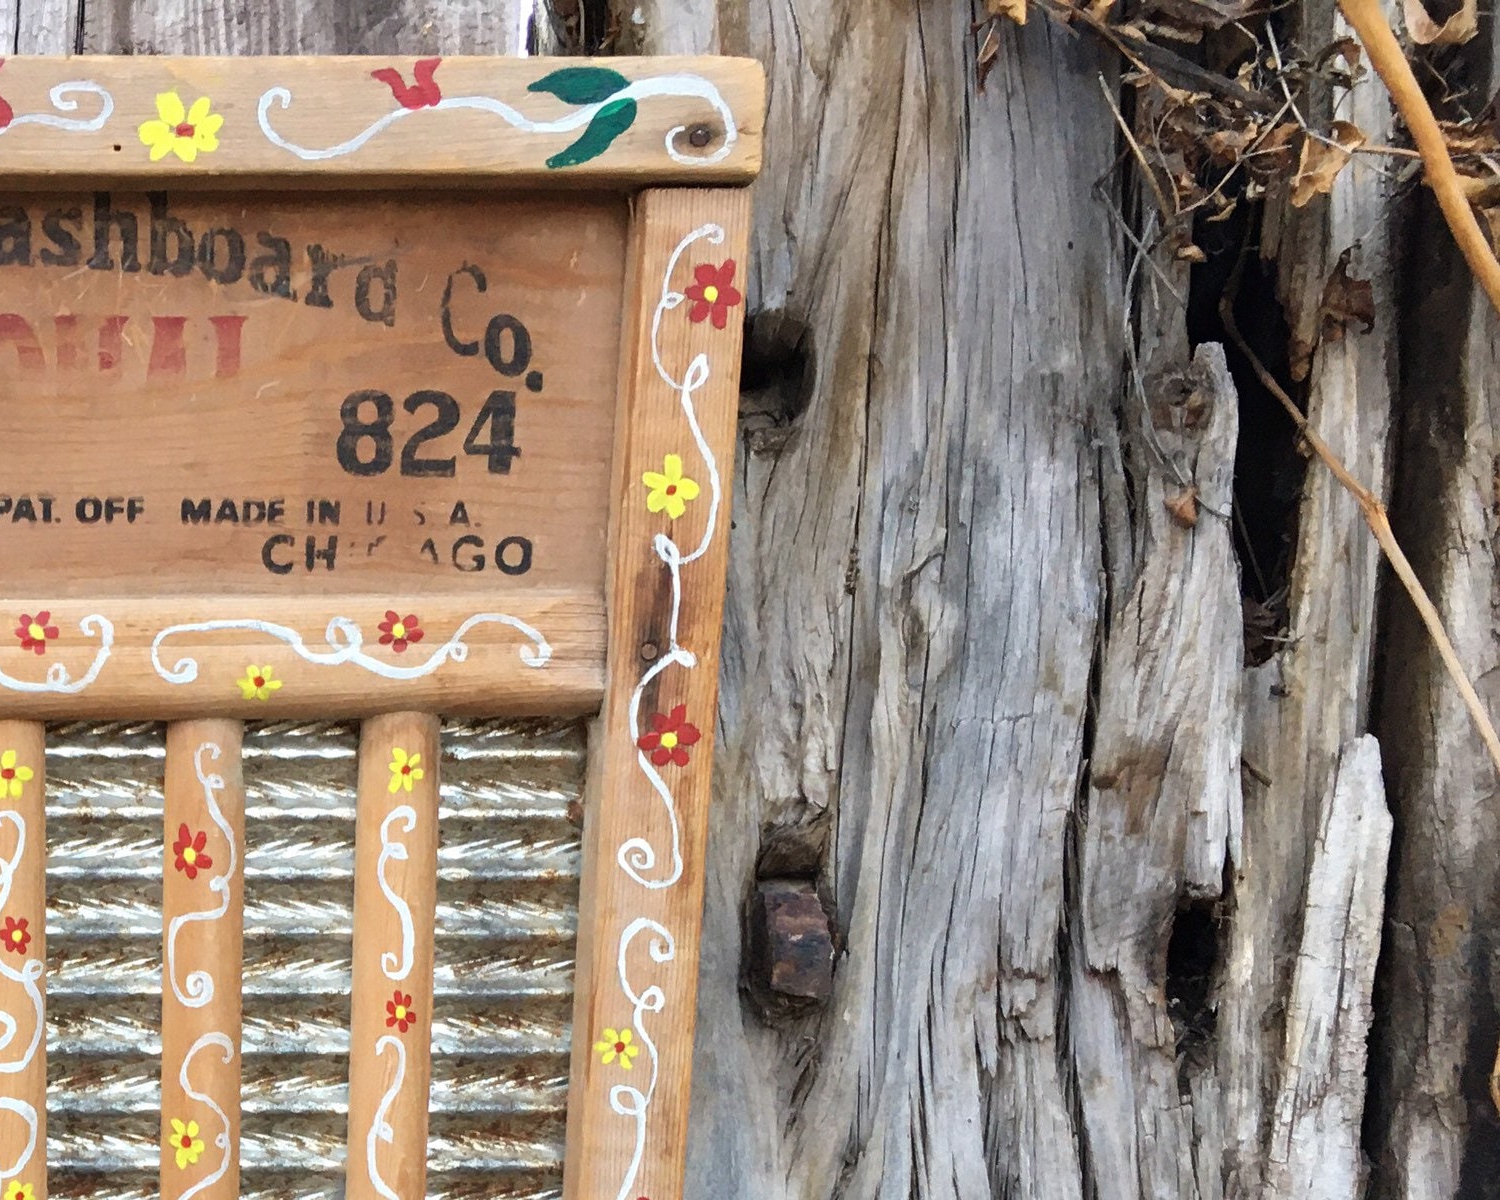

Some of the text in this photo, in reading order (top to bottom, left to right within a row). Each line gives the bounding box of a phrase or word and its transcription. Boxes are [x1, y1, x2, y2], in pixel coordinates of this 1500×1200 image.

[441, 260, 544, 392] Co.
[336, 389, 522, 478] 824
[75, 495, 145, 524] OFF
[180, 497, 286, 526] MADE
[306, 498, 341, 526] IN
[260, 533, 534, 576] CHAGO
